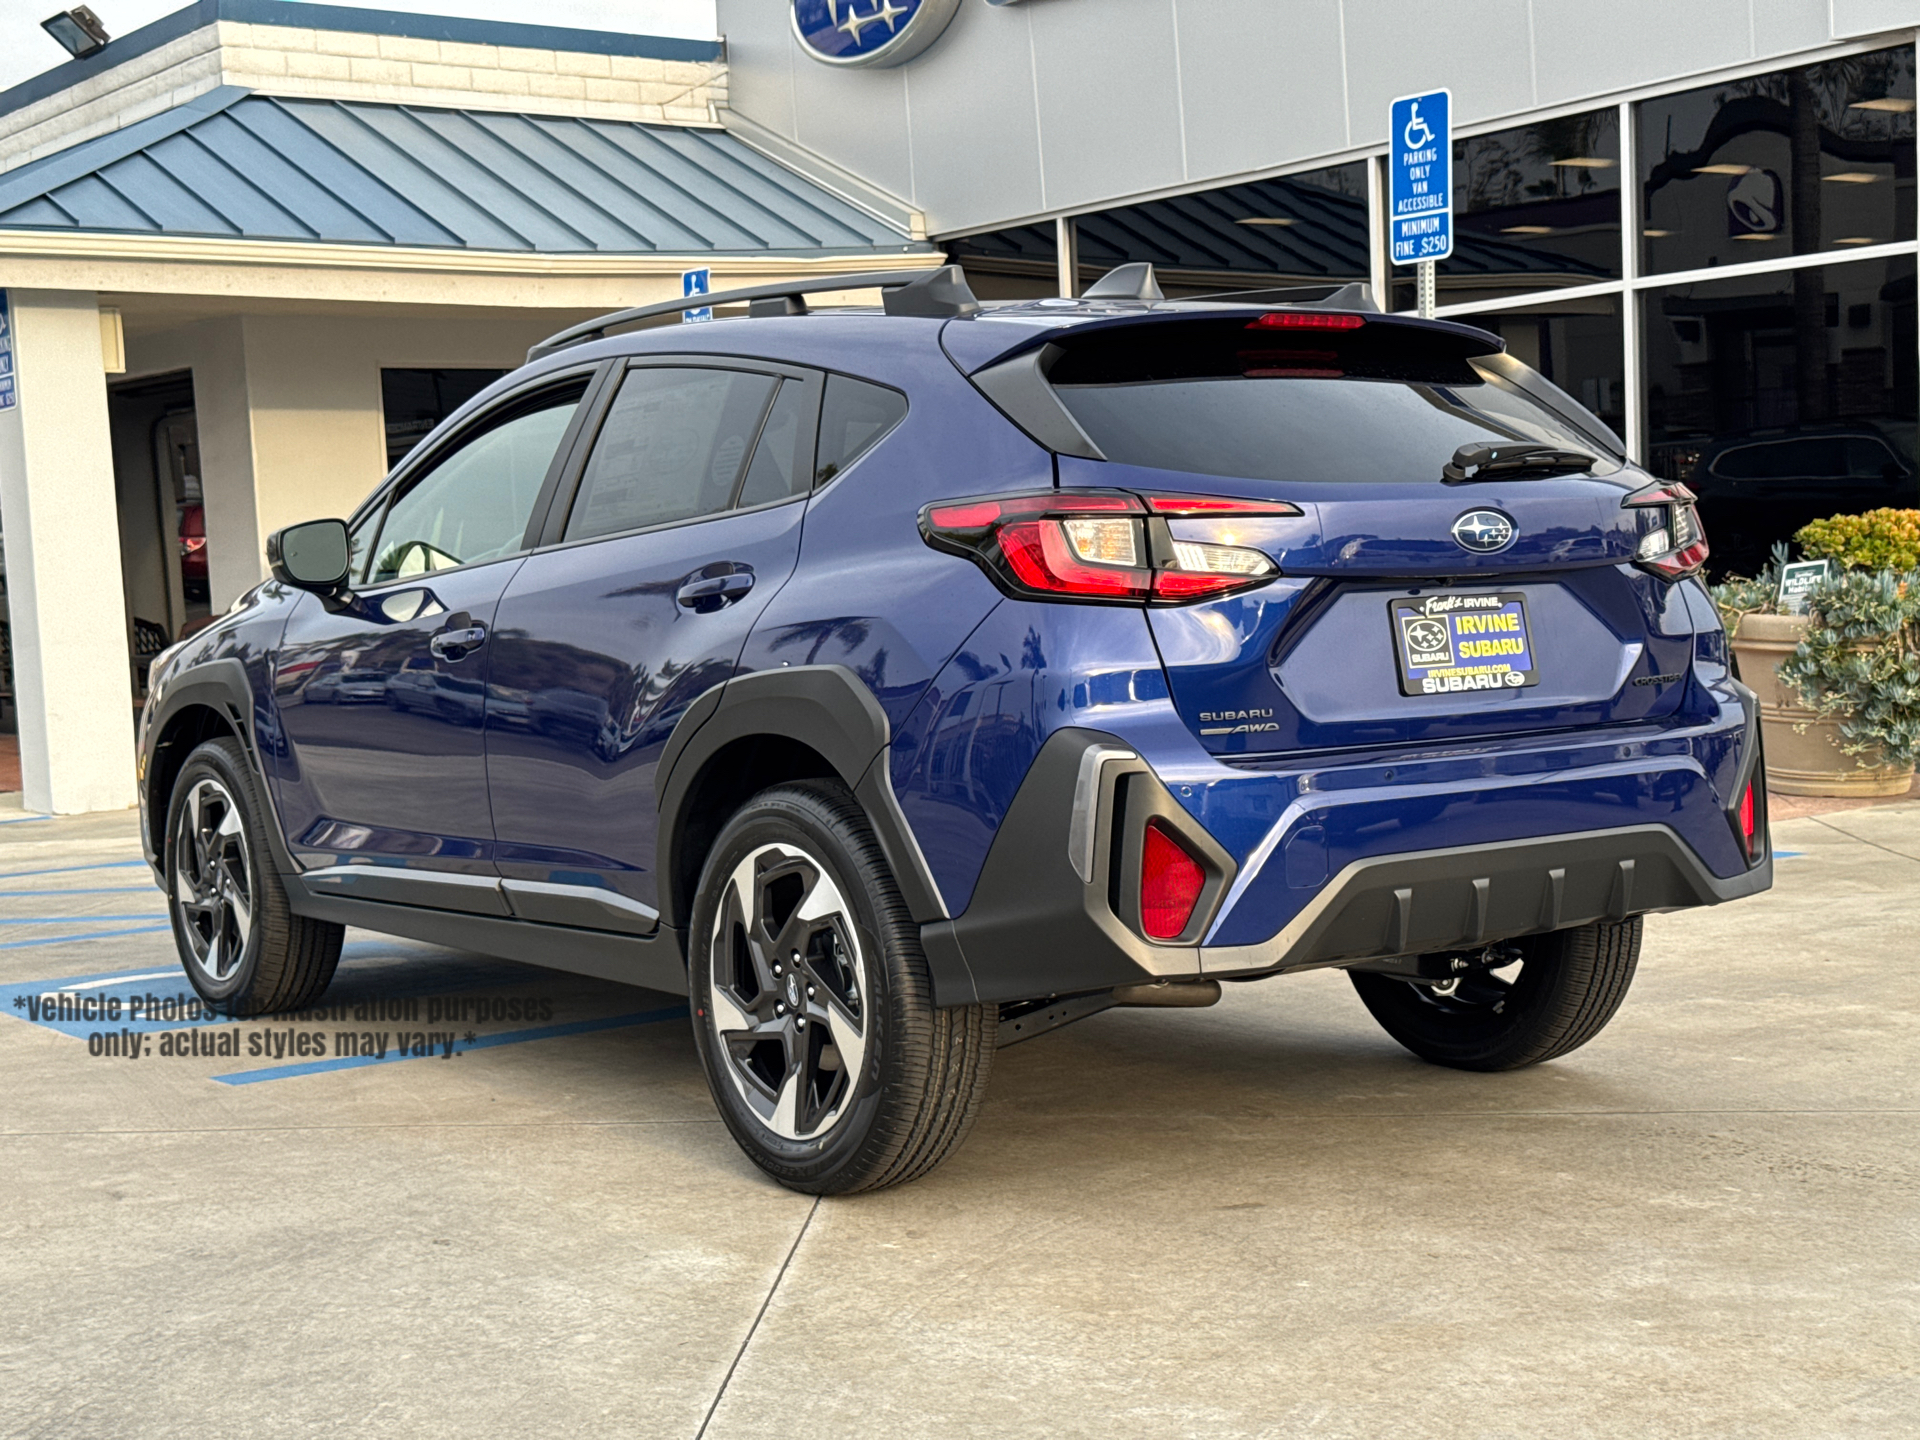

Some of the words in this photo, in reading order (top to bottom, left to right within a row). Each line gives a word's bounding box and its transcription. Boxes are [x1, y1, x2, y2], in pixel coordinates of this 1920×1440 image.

[1404, 149, 1437, 166] PARKING
[1410, 165, 1430, 180] ONLY
[1412, 181, 1428, 195] VAN
[1398, 193, 1443, 212] ACCESSIBLE
[1402, 218, 1439, 237] MINIMUM
[1395, 241, 1415, 258] FINE
[1421, 234, 1447, 255] $250
[1463, 597, 1499, 608] IRVINE
[1455, 613, 1520, 635] IRVINE
[1458, 637, 1524, 659] SUBARU
[1411, 651, 1450, 663] SUBARU
[1422, 673, 1503, 694] SUBARU
[1199, 708, 1273, 721] SUBARU
[1231, 722, 1280, 734] AWD
